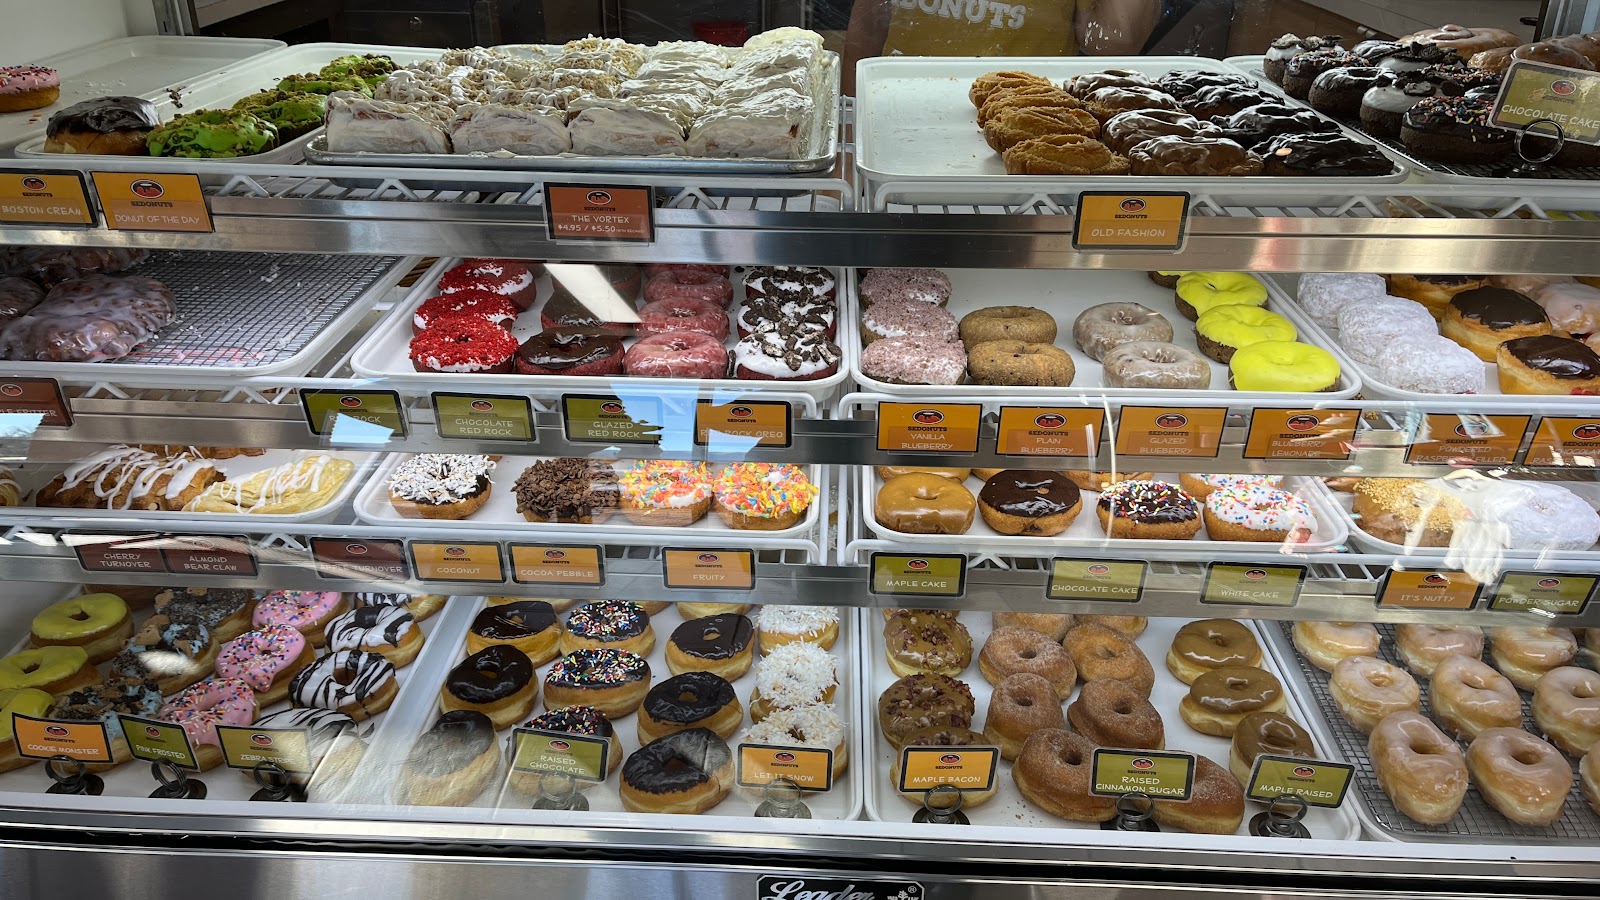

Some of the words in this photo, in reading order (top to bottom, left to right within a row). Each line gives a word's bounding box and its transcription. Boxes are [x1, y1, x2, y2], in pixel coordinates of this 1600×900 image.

[1501, 104, 1567, 123] CHOCOLATE
[1570, 116, 1600, 129] CAKE
[2, 205, 44, 215] BOSTON
[46, 206, 82, 217] CREAM
[115, 214, 147, 223] DONUT
[148, 215, 161, 223] OF
[162, 216, 180, 224] THE
[181, 216, 200, 225] DAY
[571, 214, 591, 222] THE
[593, 216, 630, 224] VORTEX
[591, 225, 616, 233] $5.50
[1091, 228, 1115, 237] OLD
[1117, 228, 1165, 237] FASHION
[455, 418, 513, 428] CHOCOLATE
[593, 421, 634, 430] GLAZED
[459, 427, 481, 435] RED
[484, 428, 512, 436] ROCK
[588, 429, 610, 437] RED
[613, 430, 640, 438] ROCK
[756, 430, 783, 438] OREO
[1150, 437, 1186, 445] GLAZED
[901, 442, 953, 450] BLUEBERRY
[1139, 446, 1193, 455] BLUEBERRY
[1021, 447, 1074, 455] BLUEBERRY
[1476, 455, 1507, 463] FILLED
[189, 555, 227, 563] ALMOND
[100, 560, 151, 568] TURNOVER
[184, 563, 211, 571] BEAR
[353, 565, 403, 573] TURNOVER
[521, 569, 554, 577] COCOA
[557, 570, 594, 578] PEBBLE
[886, 580, 918, 588] MAPLE
[1051, 584, 1108, 593] CHOCOLATE
[1221, 589, 1250, 597] WHITE
[1252, 591, 1279, 599] CAKE
[1499, 597, 1541, 606] POWDER
[1543, 598, 1580, 607] SUGAR
[27, 743, 57, 752] COOKIE
[58, 746, 99, 755] MONSTER
[136, 744, 151, 754] PINK
[153, 746, 186, 759] FROSTED
[240, 753, 267, 763] ZEBRA
[540, 755, 576, 764] RAISED
[529, 761, 585, 774] CHOCOLATE
[754, 772, 771, 780] LET
[773, 773, 783, 781] IT
[786, 774, 815, 782] SNOW
[912, 776, 946, 784] MAPLE
[948, 776, 981, 784] BACON
[1122, 775, 1160, 785] RAISED
[1095, 783, 1147, 794] CINNAMON
[1149, 786, 1185, 796] SUGAR
[1259, 784, 1293, 795] MAPLE
[1295, 787, 1333, 798] RAISED
